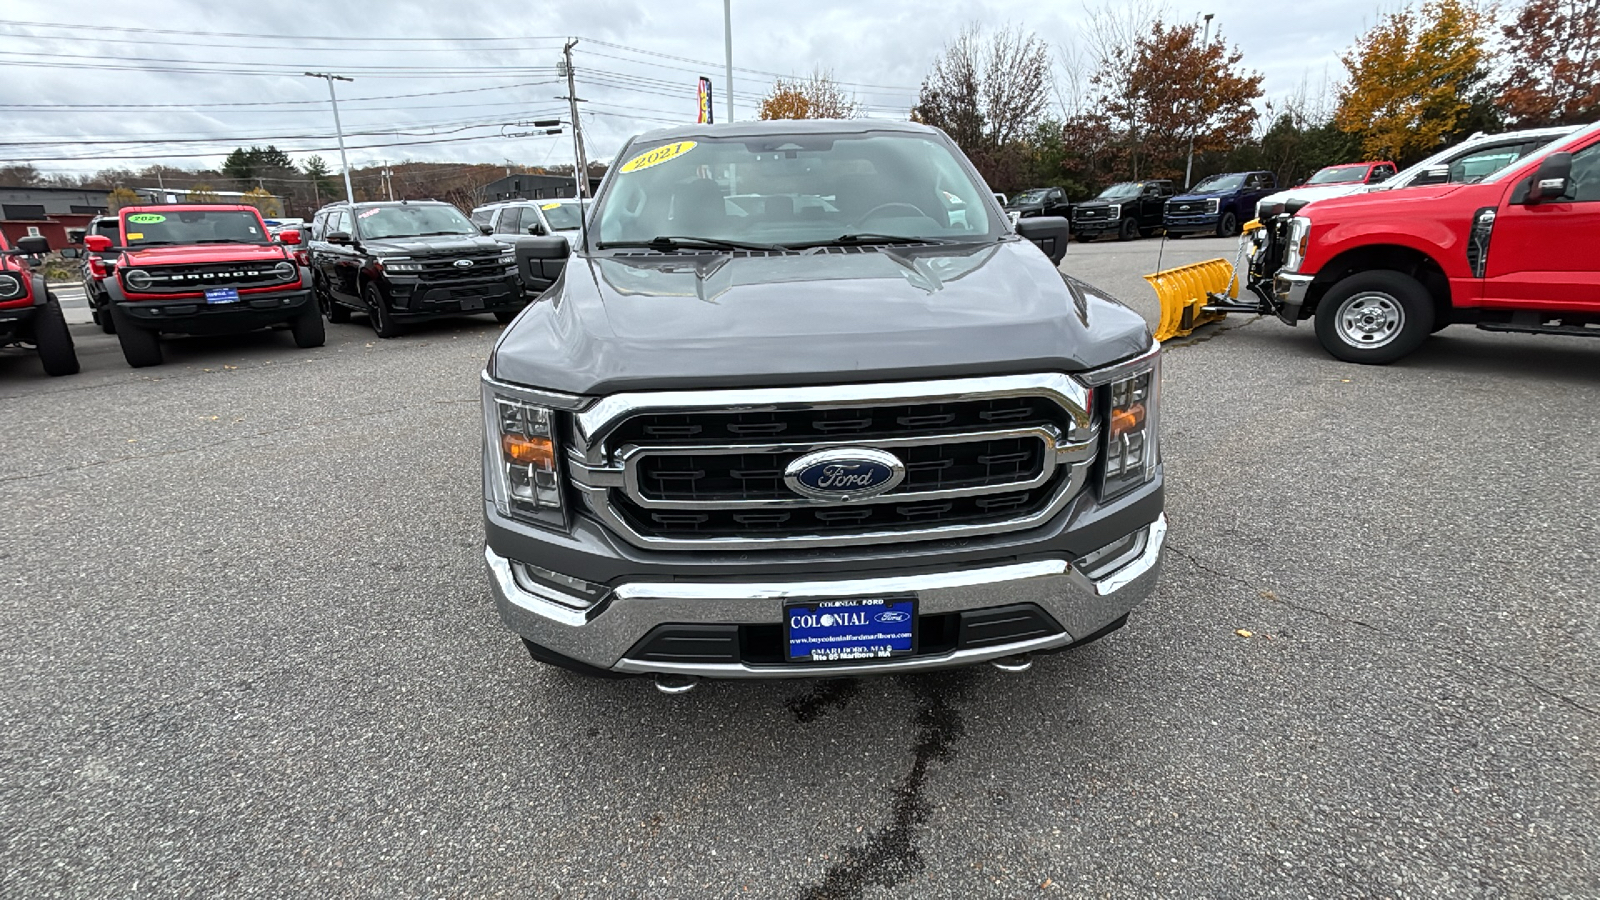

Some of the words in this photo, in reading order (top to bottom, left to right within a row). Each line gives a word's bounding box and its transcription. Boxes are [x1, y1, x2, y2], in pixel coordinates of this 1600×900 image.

[633, 143, 683, 170] 2021
[171, 270, 259, 280] BRONCO
[818, 464, 874, 488] Ford
[819, 600, 859, 609] COLONIAL
[862, 598, 884, 606] FORD
[791, 612, 869, 629] COLONIAL
[881, 612, 903, 622] Ford
[789, 632, 912, 644] www.buycolonialfordmarlboro.com
[813, 653, 827, 661] Rte
[840, 651, 874, 660] Marlboro
[877, 650, 891, 658] MA
